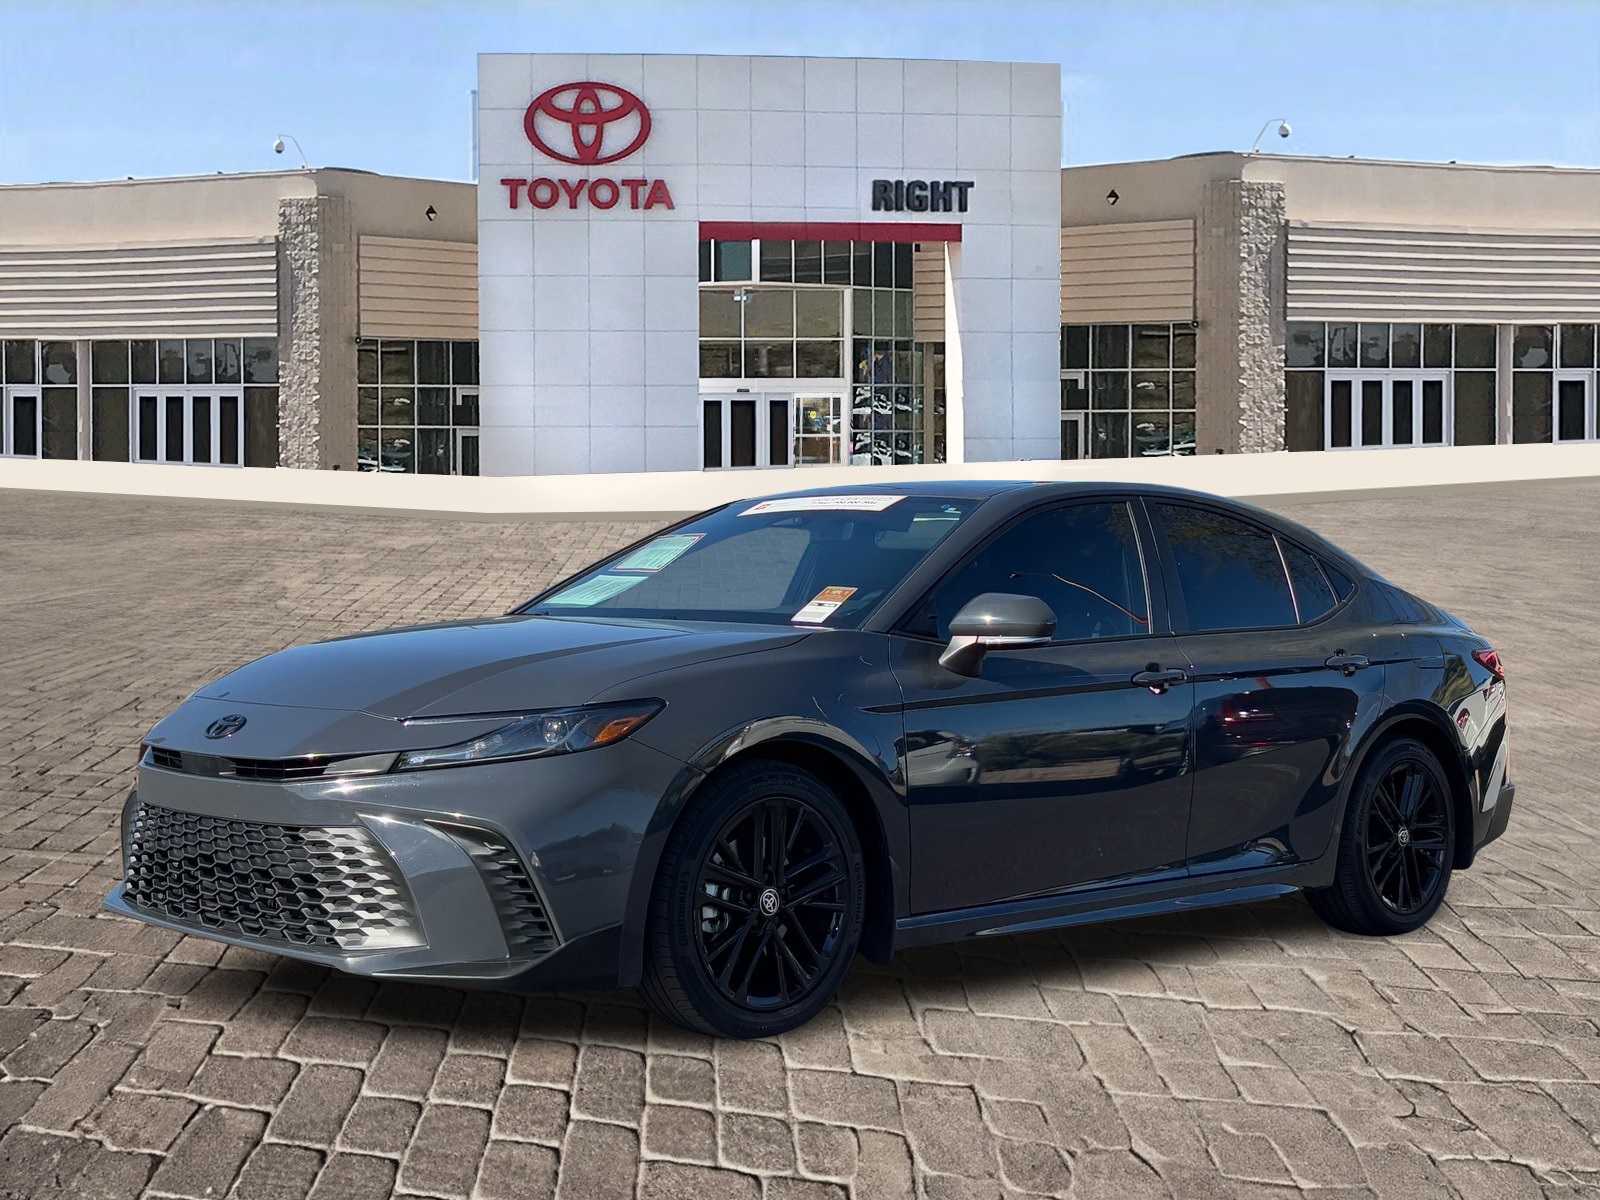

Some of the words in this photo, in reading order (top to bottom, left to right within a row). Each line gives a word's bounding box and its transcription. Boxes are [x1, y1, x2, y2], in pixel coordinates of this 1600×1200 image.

[500, 177, 675, 210] TOYOTA
[872, 179, 975, 212] RIGHT
[677, 879, 689, 946] Continental
